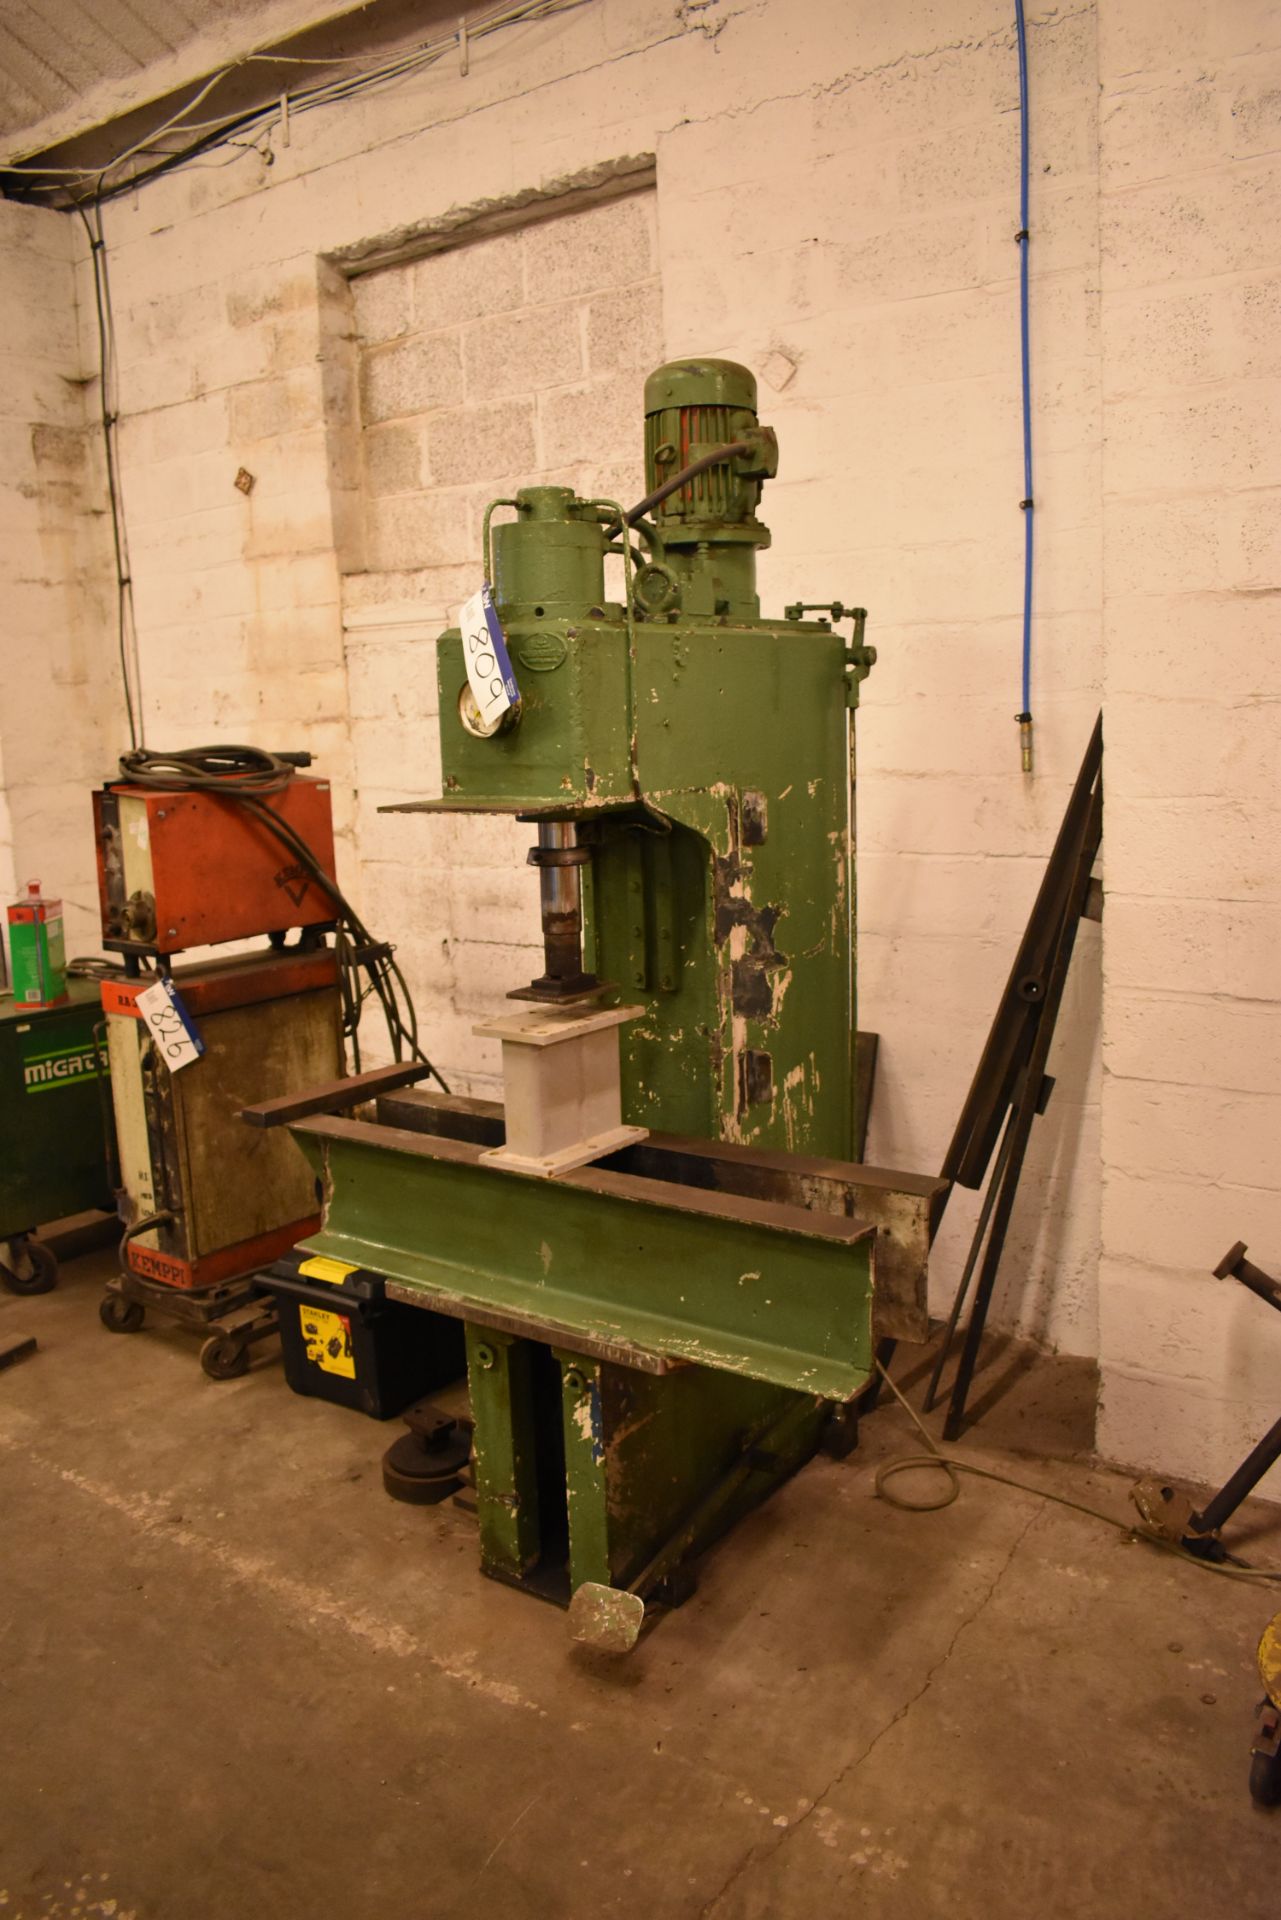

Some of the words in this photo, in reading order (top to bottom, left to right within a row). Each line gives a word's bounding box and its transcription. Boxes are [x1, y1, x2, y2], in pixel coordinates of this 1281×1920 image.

[469, 626, 504, 709] 809
[149, 1004, 183, 1059] 826
[131, 1251, 186, 1285] KEMPPI
